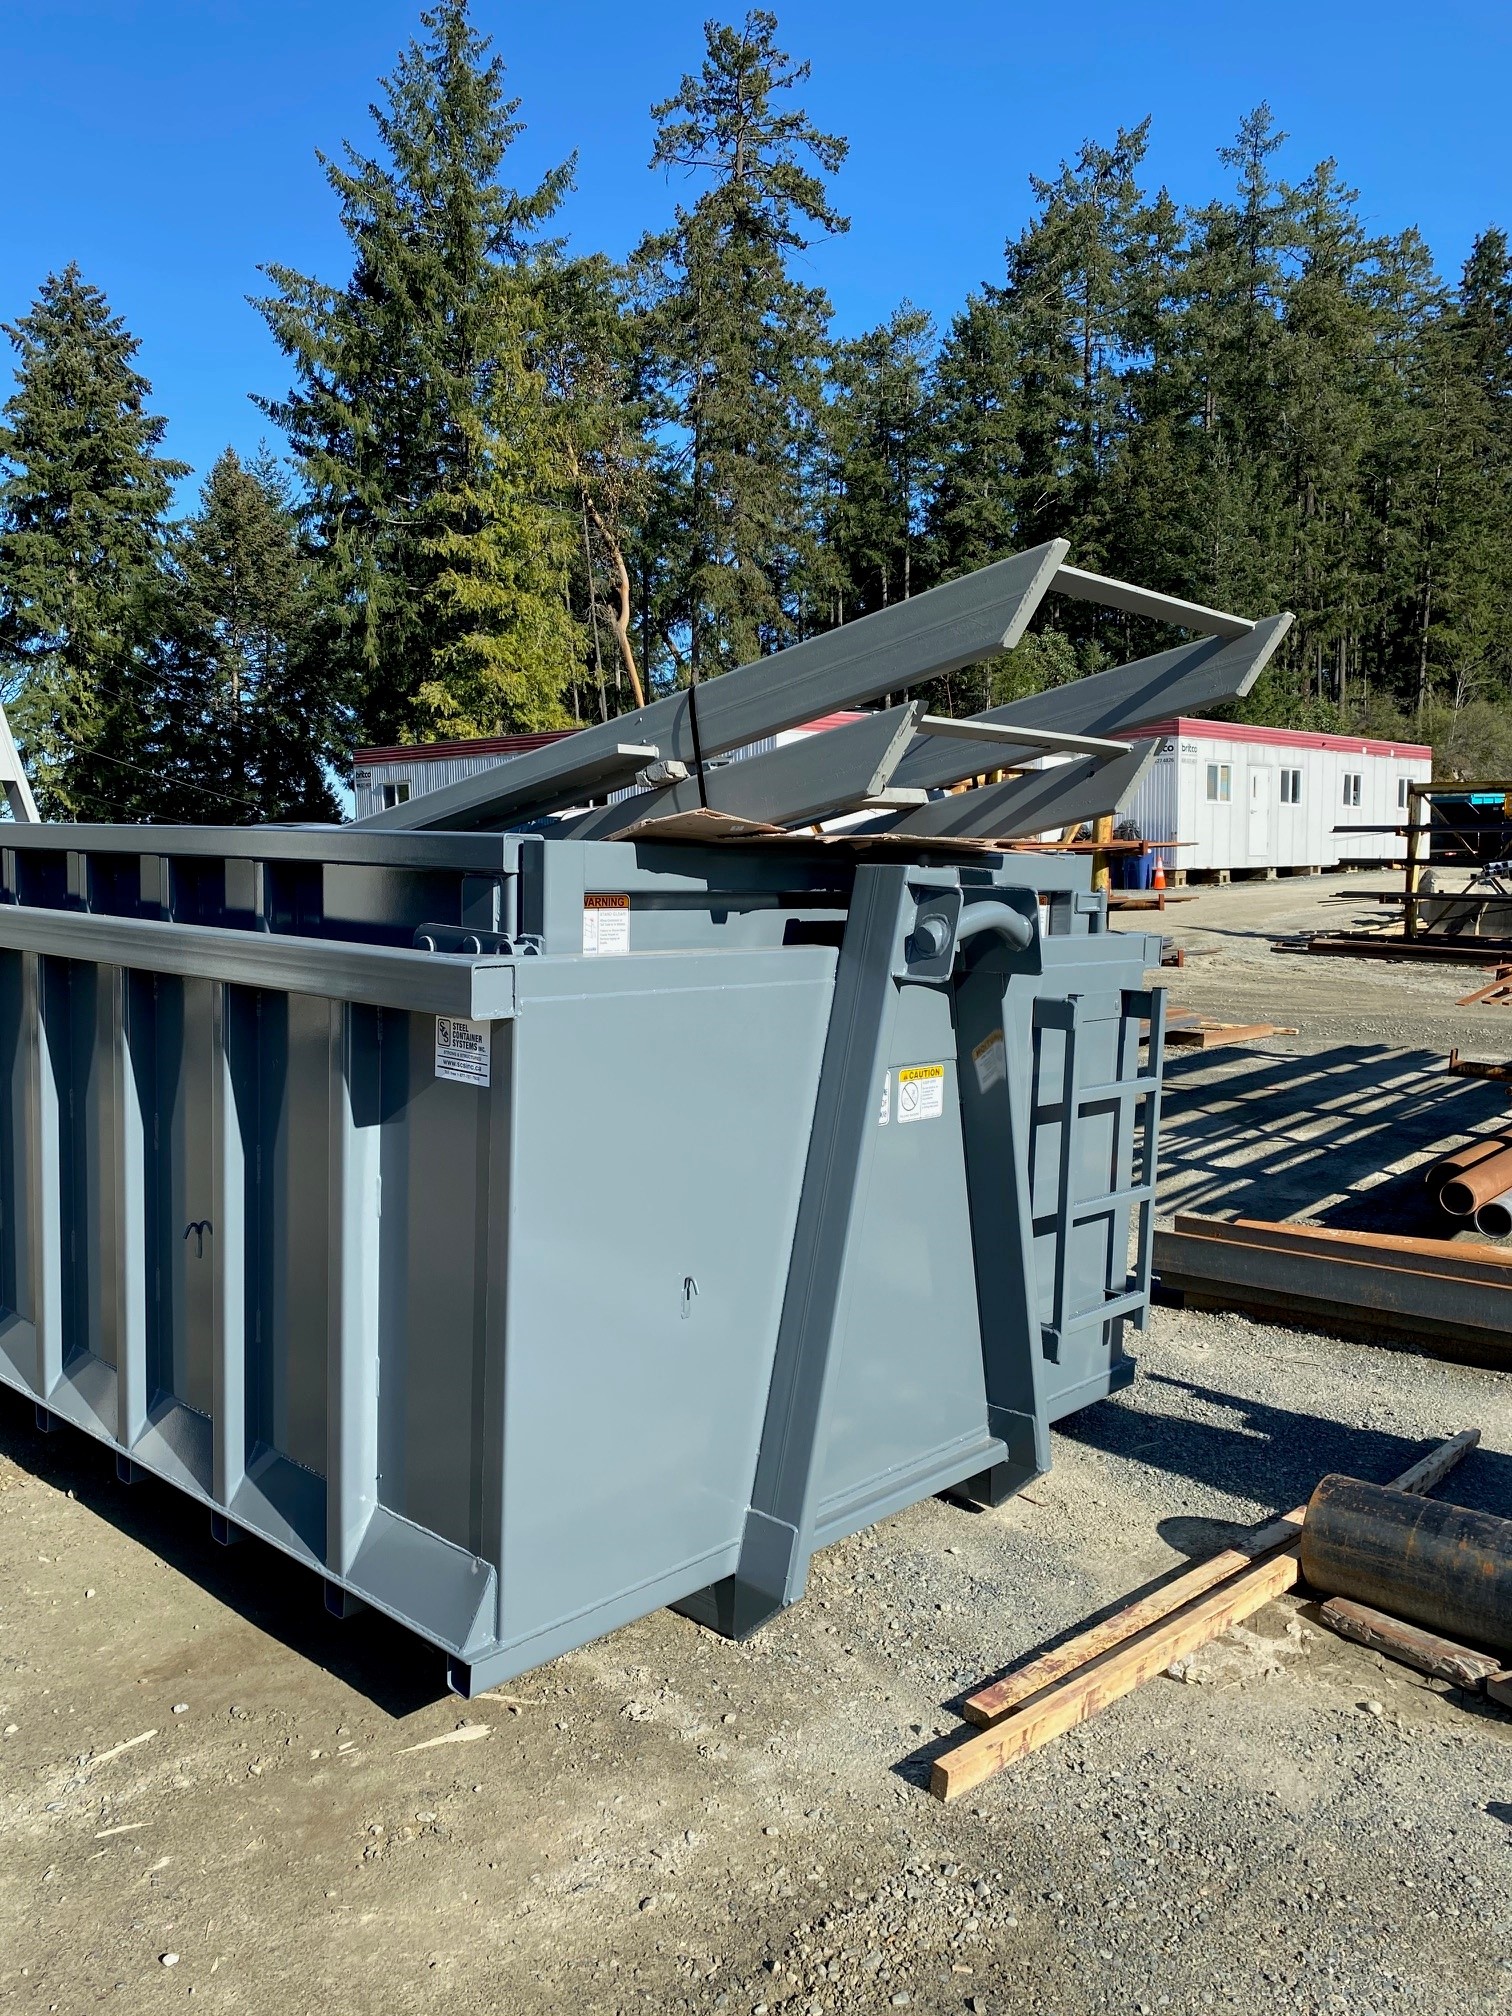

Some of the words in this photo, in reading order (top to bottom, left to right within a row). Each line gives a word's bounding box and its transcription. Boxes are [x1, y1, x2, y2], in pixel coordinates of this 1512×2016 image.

[1181, 744, 1198, 753] britco
[356, 770, 371, 778] britco
[452, 1022, 469, 1033] STEEL
[452, 1030, 483, 1044] CONTAINER
[452, 1039, 478, 1051] SYSTEMS
[443, 1059, 482, 1072] www.scsinc.ca
[909, 1068, 940, 1079] CAUTION
